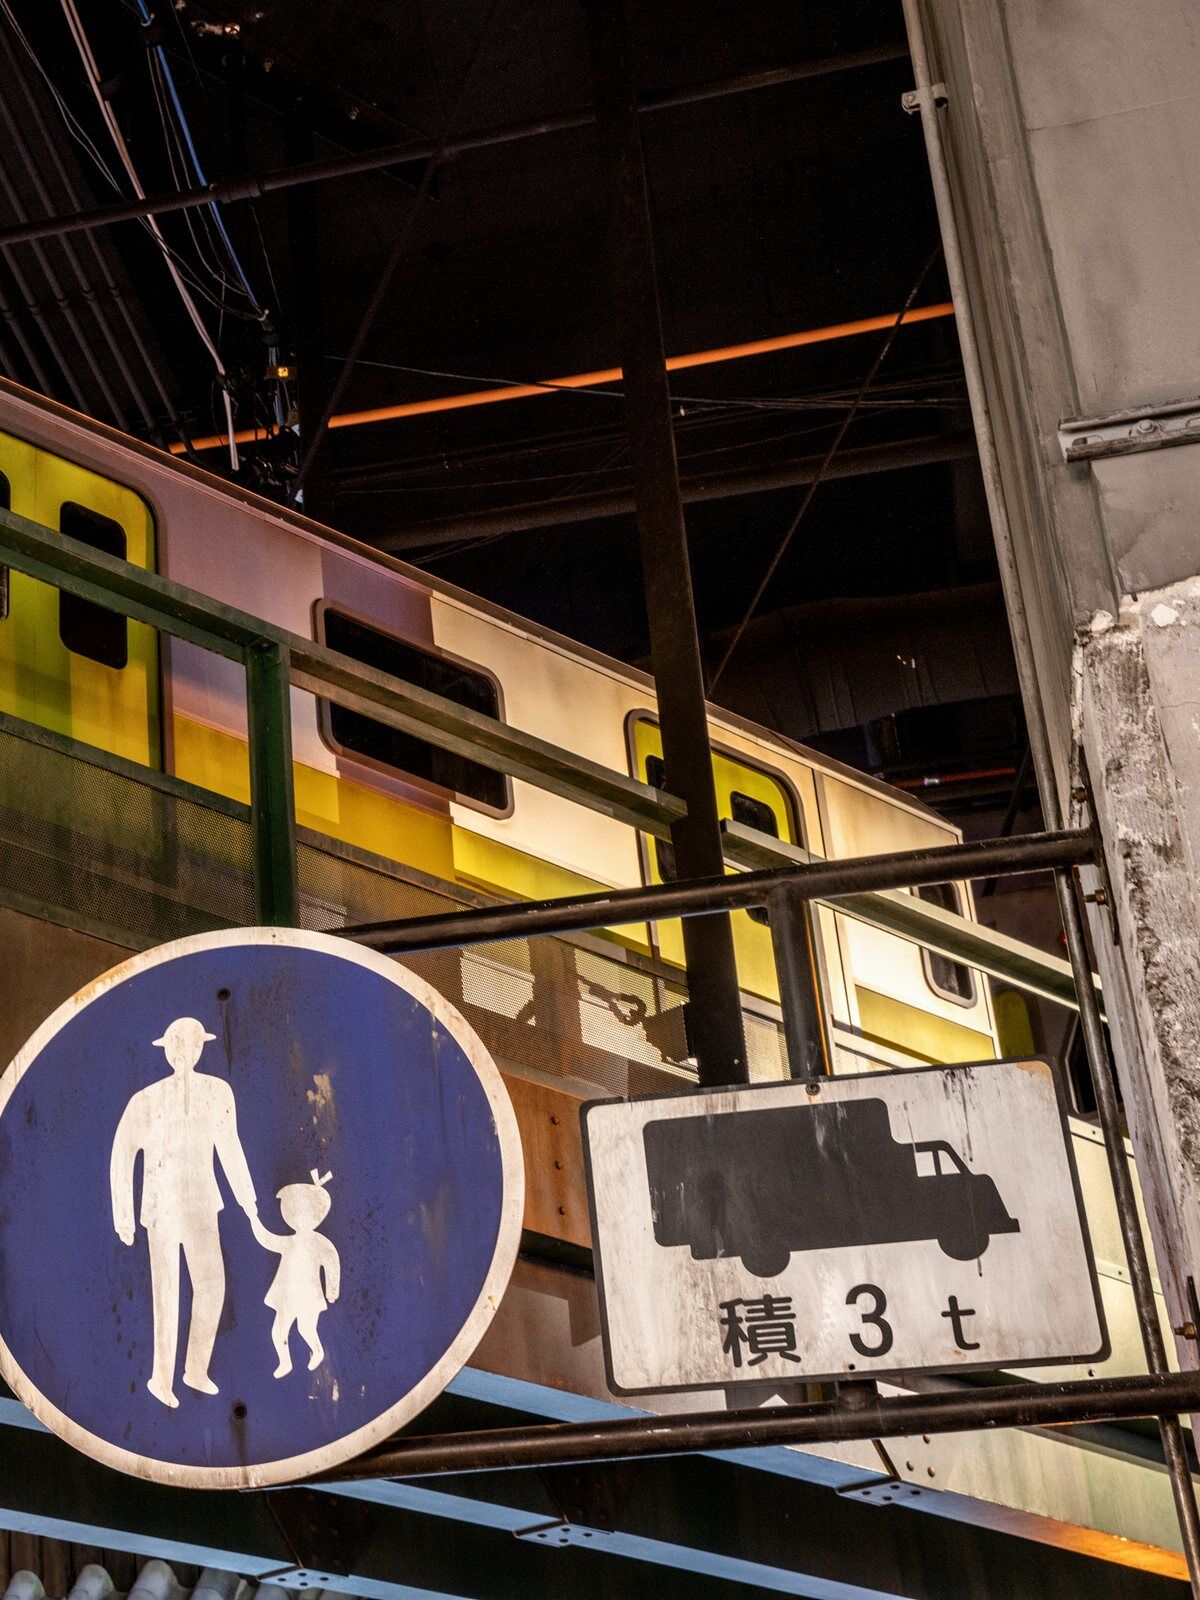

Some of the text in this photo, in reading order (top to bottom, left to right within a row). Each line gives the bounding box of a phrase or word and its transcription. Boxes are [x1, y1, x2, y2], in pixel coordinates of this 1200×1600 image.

[718, 1283, 980, 1367] 積 3 t
